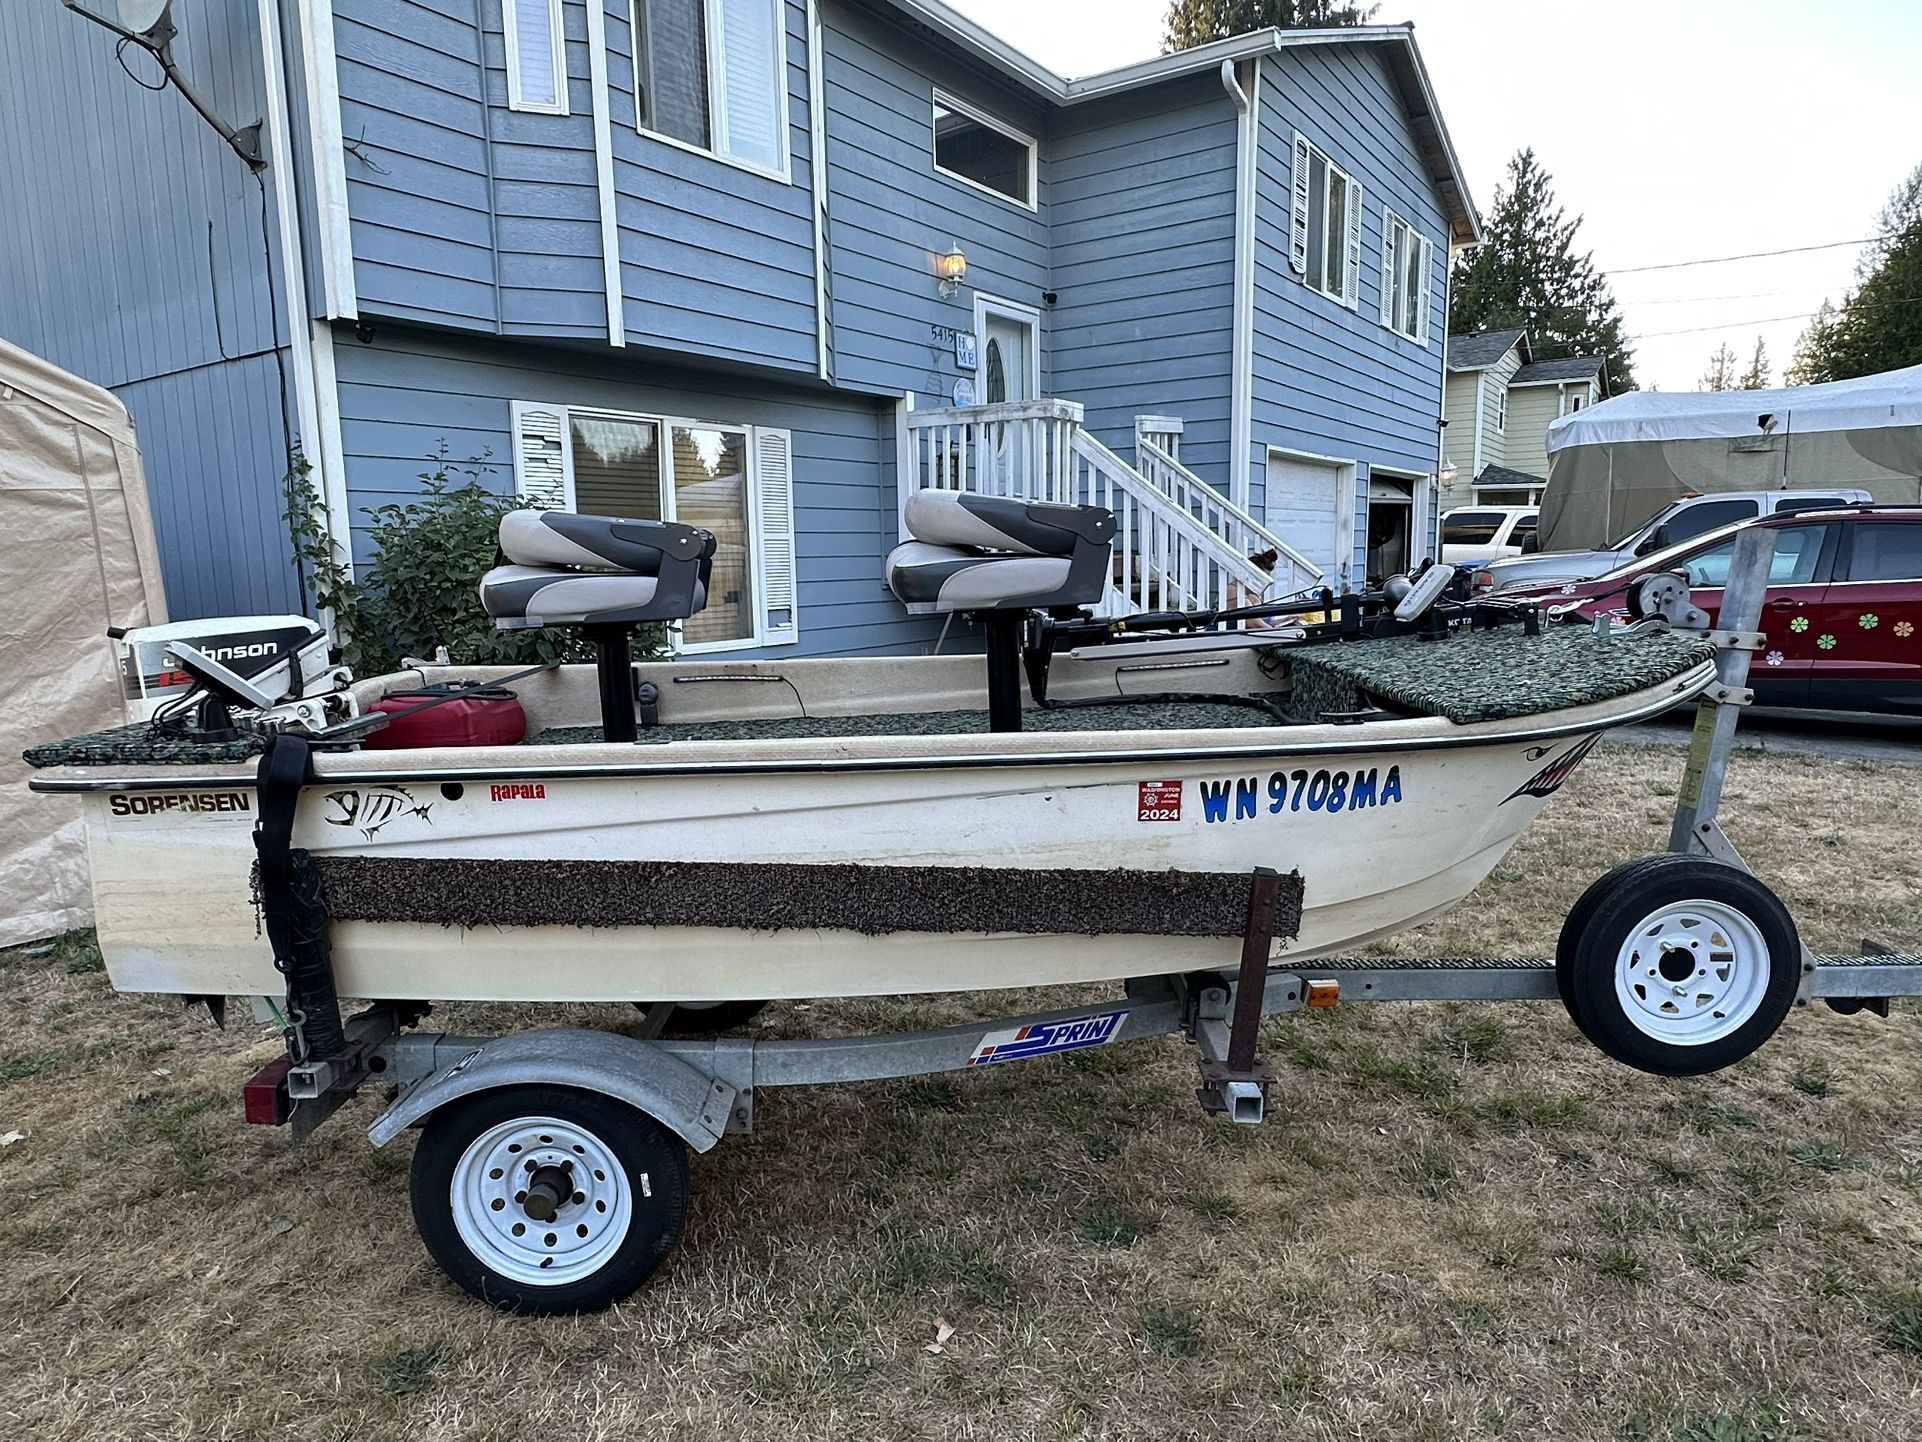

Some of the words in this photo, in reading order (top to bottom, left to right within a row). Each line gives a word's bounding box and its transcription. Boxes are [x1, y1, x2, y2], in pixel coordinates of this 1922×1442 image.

[931, 326, 954, 343] 5415
[109, 792, 250, 816] SORENSEN
[1200, 777, 1258, 823] WN
[1268, 765, 1403, 814] 9708MA
[1140, 809, 1179, 820] 2024
[1022, 1010, 1130, 1047] SPRINT
